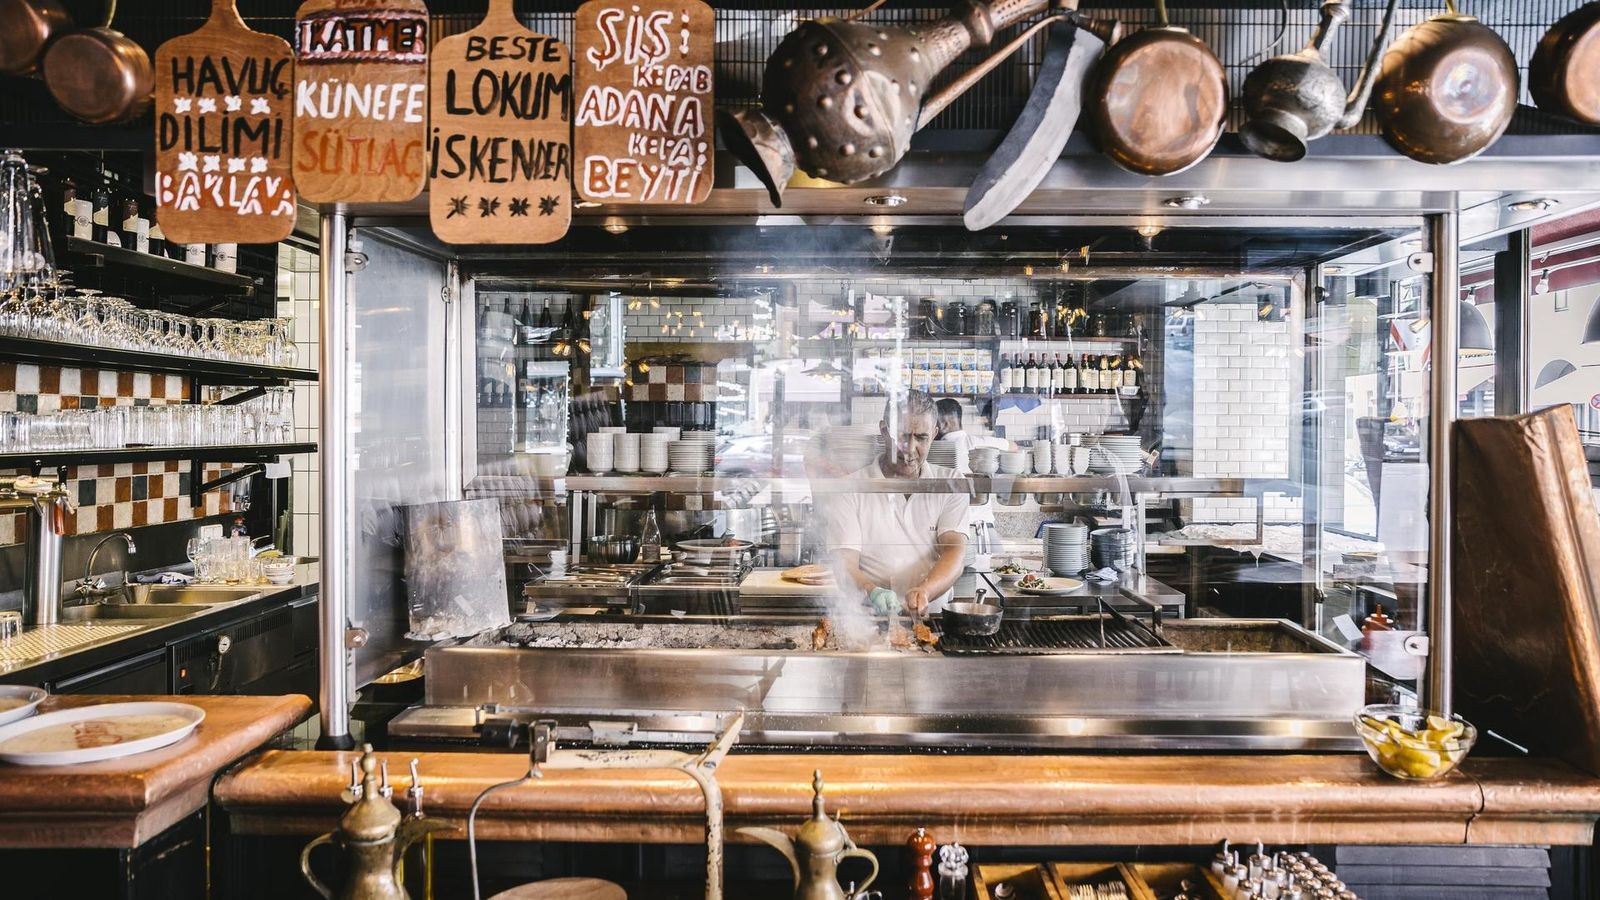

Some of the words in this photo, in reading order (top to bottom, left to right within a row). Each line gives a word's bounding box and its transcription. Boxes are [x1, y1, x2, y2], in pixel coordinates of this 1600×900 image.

[466, 35, 562, 63] BESTE
[171, 55, 291, 101] HAVUÇ
[296, 78, 425, 123] KÜNEFE
[446, 67, 570, 121] LOKUM
[575, 85, 706, 139] ADANA
[298, 128, 423, 182] SÜTLAÇ
[430, 127, 570, 183] İSKENDER
[155, 171, 297, 217] BAKLAVA
